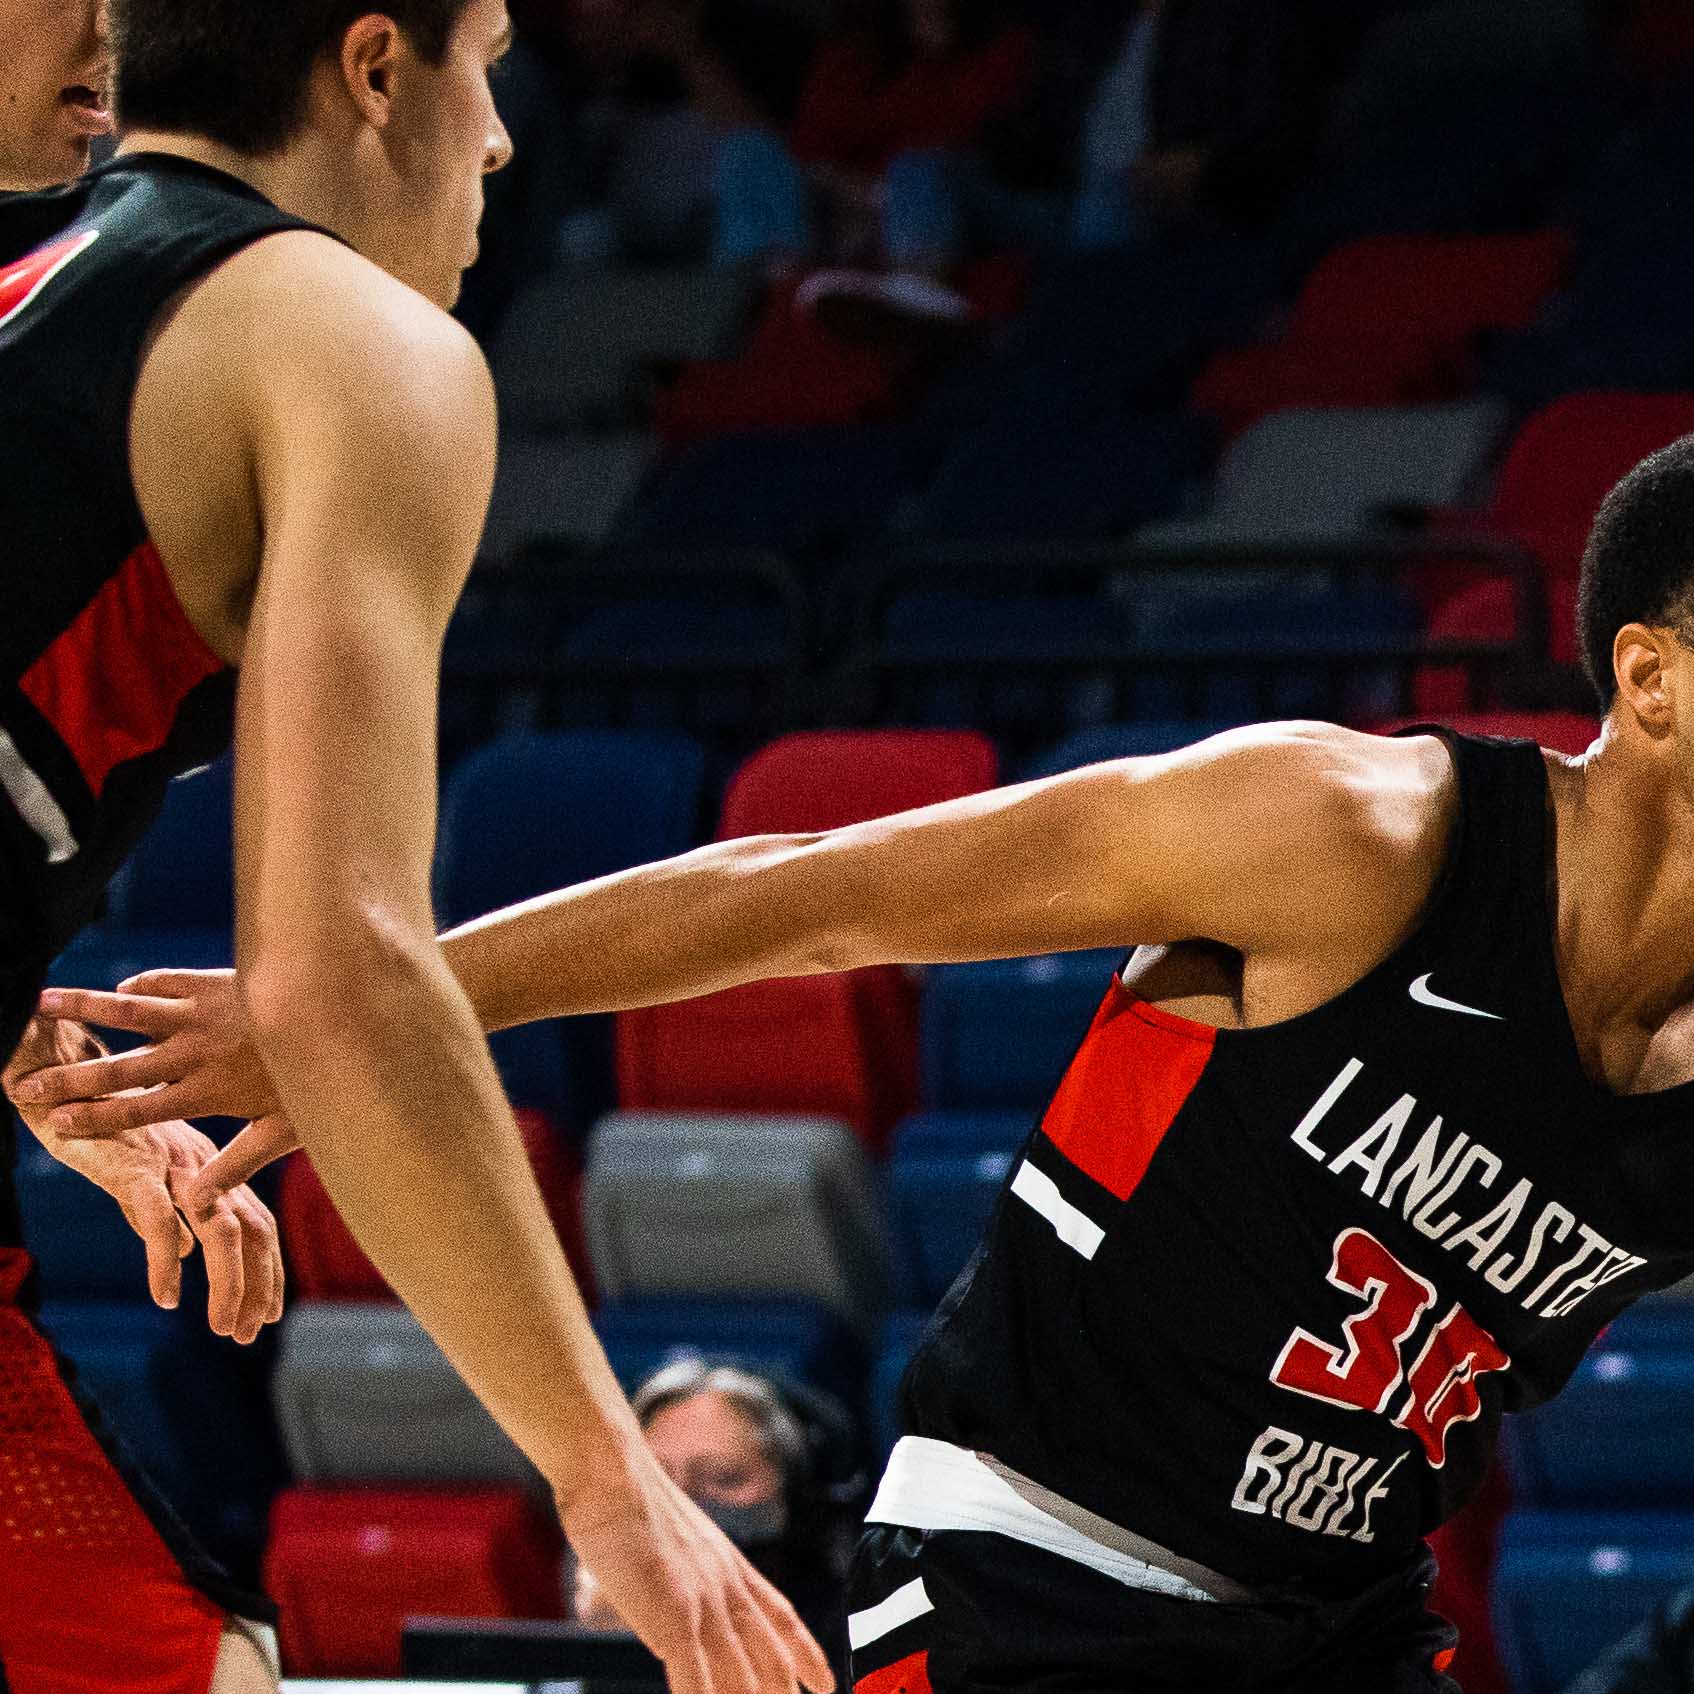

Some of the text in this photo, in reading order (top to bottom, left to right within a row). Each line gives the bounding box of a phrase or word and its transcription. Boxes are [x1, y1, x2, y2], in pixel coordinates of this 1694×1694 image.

[1290, 1057, 1648, 1318] LANCASTER
[1268, 1226, 1511, 1470] 30
[1230, 1424, 1410, 1545] BIBLE
